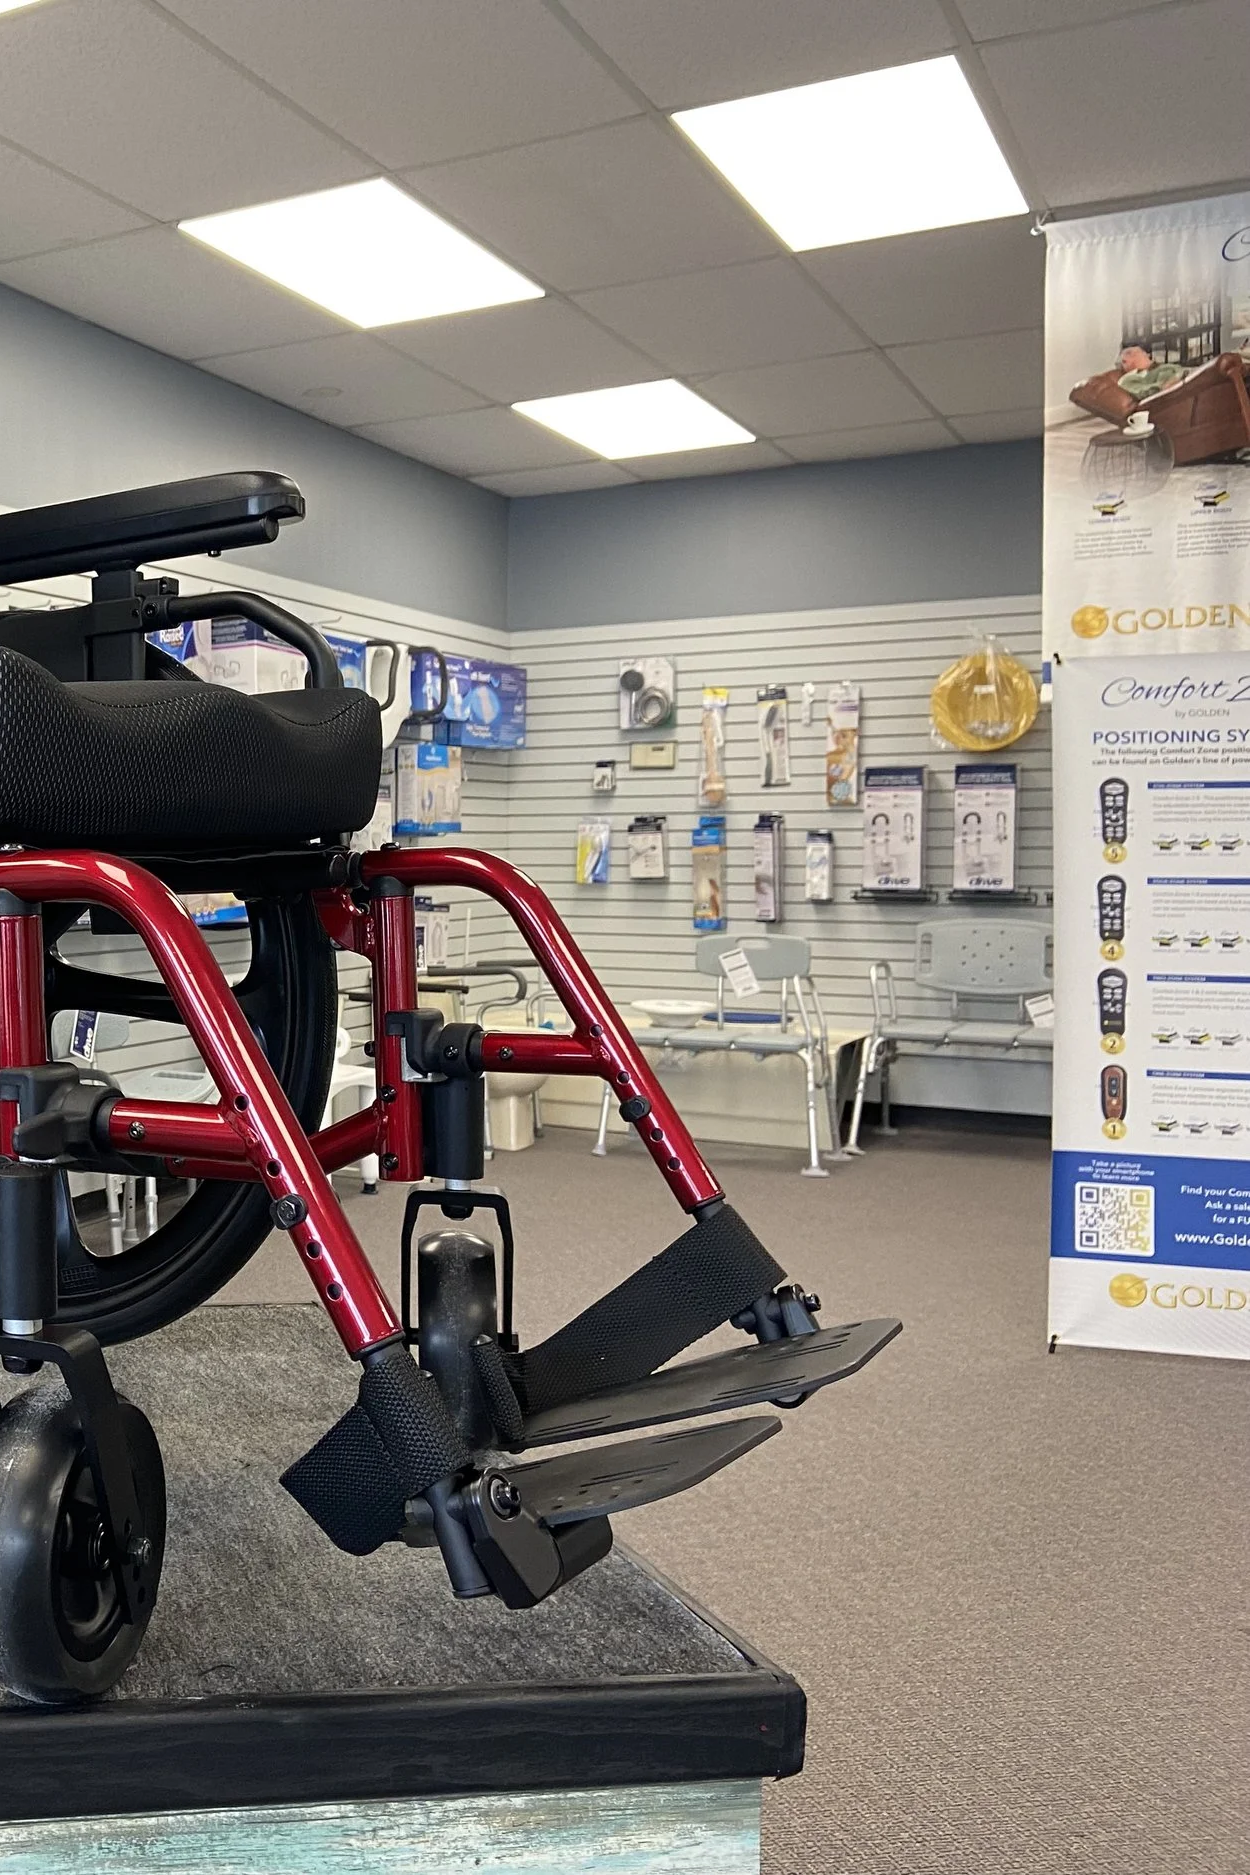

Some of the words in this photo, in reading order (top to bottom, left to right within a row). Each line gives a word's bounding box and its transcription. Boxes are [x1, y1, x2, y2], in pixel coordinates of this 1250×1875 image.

[1101, 676, 1232, 708] Comfort
[1175, 709, 1186, 719] by
[1188, 708, 1230, 717] GOLDEN
[1093, 729, 1221, 745] POSITIONING
[1227, 728, 1250, 743] SY
[1101, 747, 1116, 756] The
[1118, 747, 1158, 756] following
[1160, 746, 1196, 755] Comfort
[1197, 745, 1219, 754] Zone
[1109, 757, 1120, 765] be
[1122, 757, 1147, 765] found
[1163, 756, 1200, 765] Golden's
[1203, 756, 1218, 764] line
[1220, 756, 1230, 764] of
[878, 876, 910, 885] drive
[969, 876, 1002, 886] drive
[1108, 946, 1115, 956] 4
[1110, 1038, 1117, 1050] 2
[1116, 1161, 1141, 1170] picture
[1112, 1168, 1155, 1176] smartphone
[1180, 1185, 1203, 1195] Find
[1204, 1187, 1227, 1198] your
[1204, 1200, 1224, 1210] Ask
[1225, 1203, 1232, 1211] a
[1213, 1213, 1227, 1224] for
[1229, 1216, 1236, 1225] a
